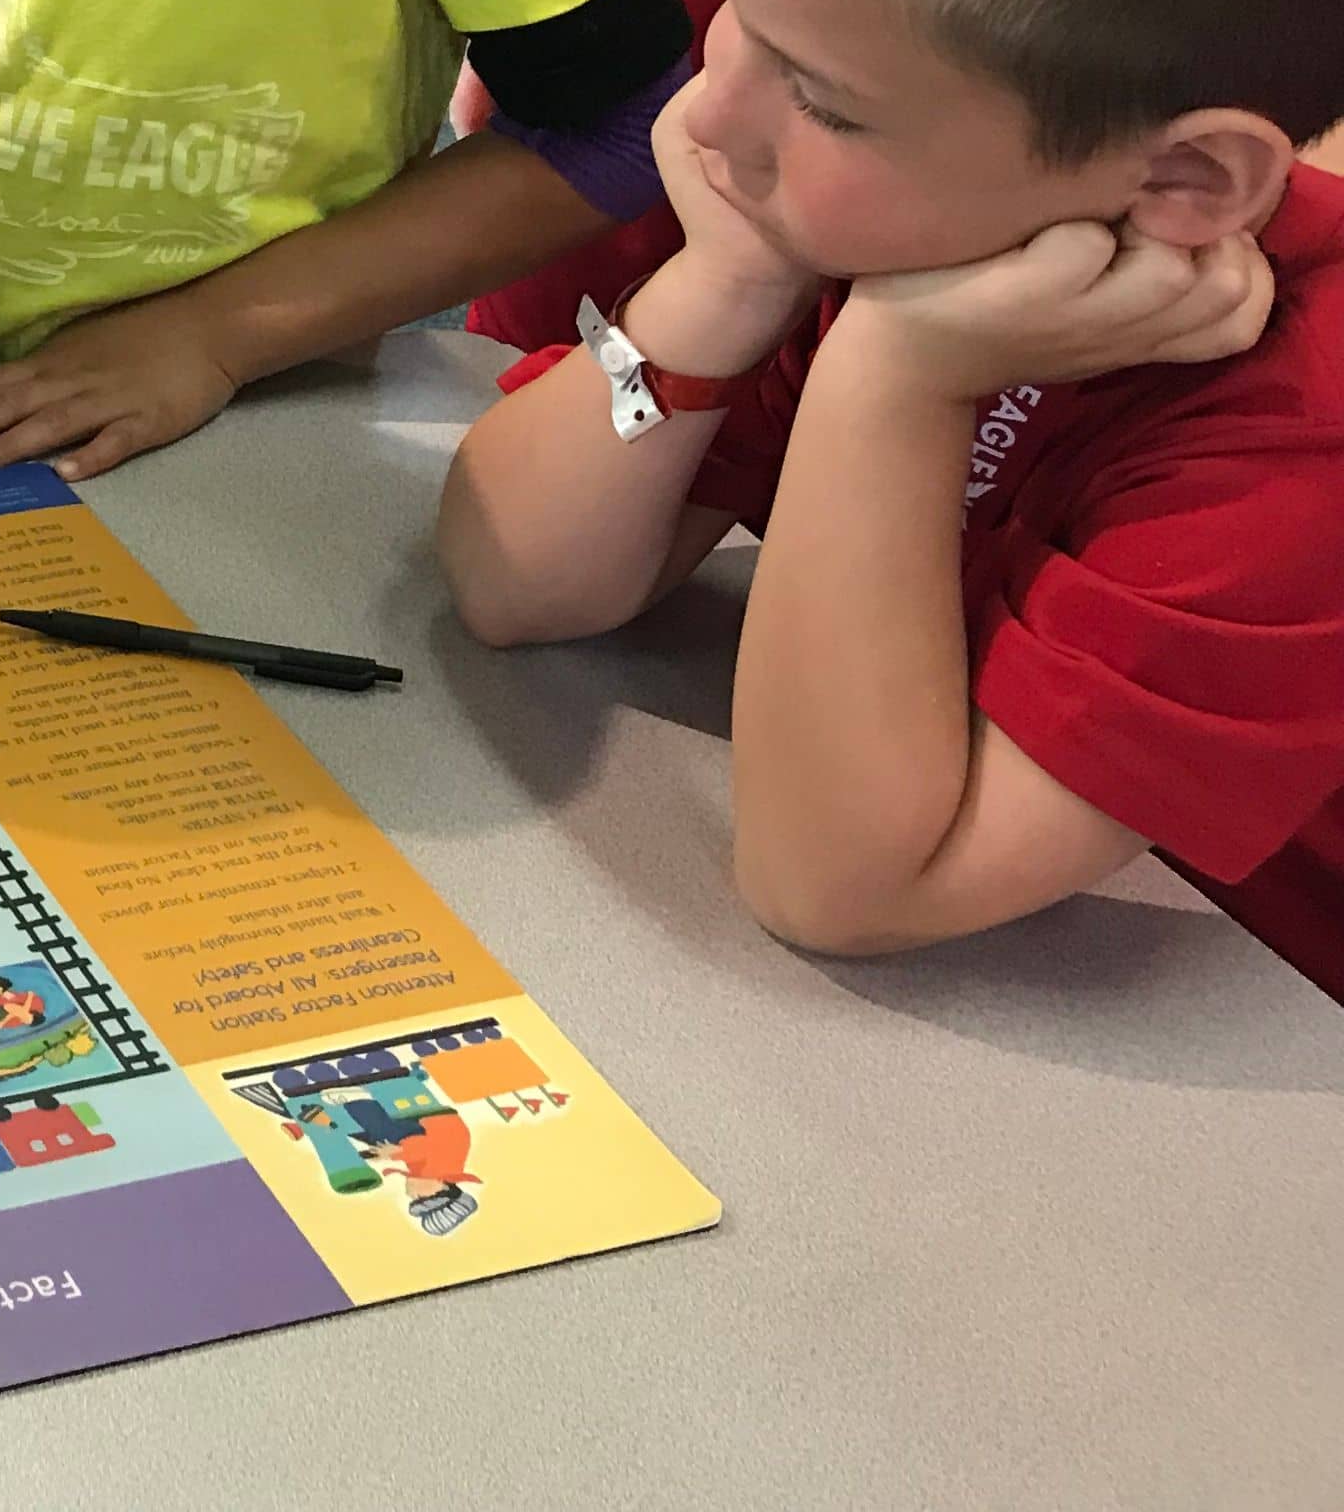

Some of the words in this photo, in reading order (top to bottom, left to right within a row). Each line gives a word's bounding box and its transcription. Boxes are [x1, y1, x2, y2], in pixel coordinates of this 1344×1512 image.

[83, 113, 292, 195] EAGLE
[28, 725, 66, 742] keep
[153, 766, 194, 783] recap
[199, 758, 252, 776] NEVER
[122, 775, 148, 788] any
[166, 783, 207, 797] reuse
[211, 772, 264, 790] NEVER
[224, 787, 275, 805] NEVER
[178, 798, 220, 815] share
[248, 829, 288, 847] drink
[194, 843, 219, 860] the
[283, 838, 325, 857] Keep
[143, 849, 191, 868] Factor
[210, 855, 250, 872] track
[255, 849, 280, 865] the
[96, 879, 133, 896] food
[199, 876, 278, 902] remember
[336, 889, 363, 903] and
[158, 891, 194, 908] your
[297, 895, 331, 911] after
[339, 904, 383, 922] Wash
[288, 913, 335, 932] hands
[199, 921, 284, 951] thoroughly
[310, 927, 420, 962] Cleanliness
[141, 942, 194, 964] before
[266, 951, 304, 972] and
[193, 957, 263, 987] Safety!
[291, 973, 317, 991] All
[360, 970, 454, 1001] Attention
[206, 980, 284, 1010] Aboard
[292, 990, 356, 1016] Factor
[173, 997, 203, 1016] for
[210, 1005, 287, 1034] Station
